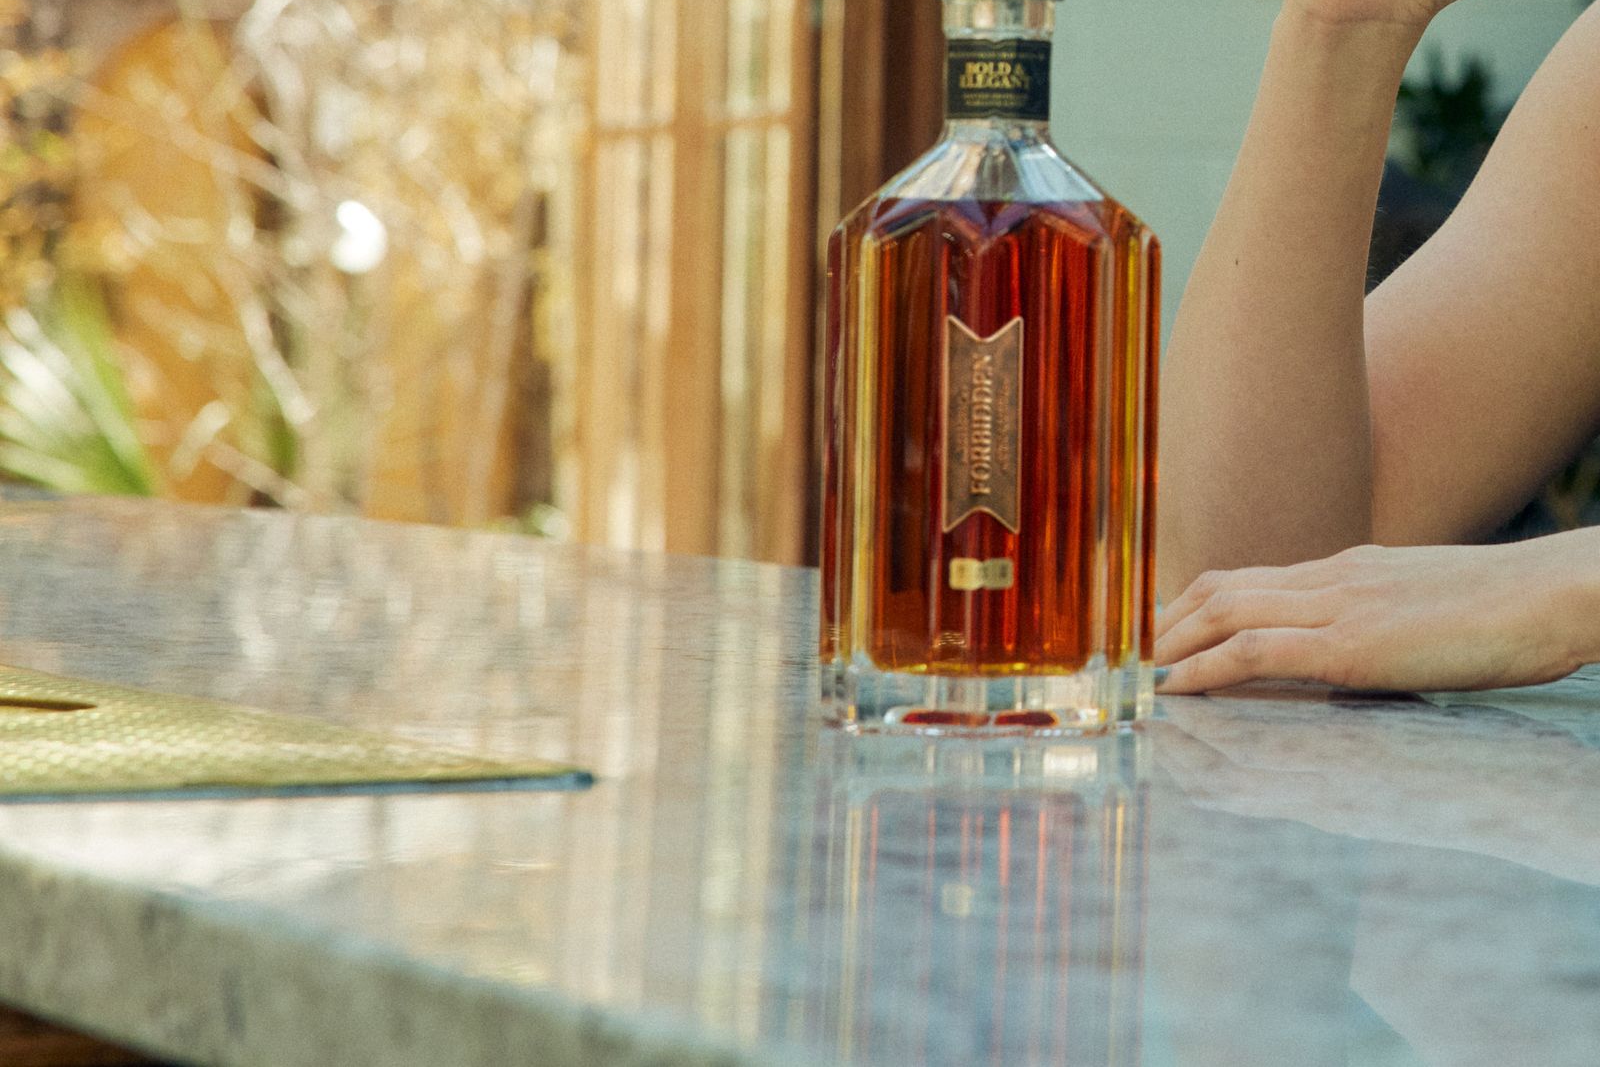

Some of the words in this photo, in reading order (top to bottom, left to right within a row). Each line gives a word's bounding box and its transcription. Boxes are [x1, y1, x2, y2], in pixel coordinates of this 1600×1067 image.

[965, 62, 1011, 74] BOLD
[959, 74, 1030, 89] ELEGANT
[970, 352, 993, 495] FORBIDDEN
